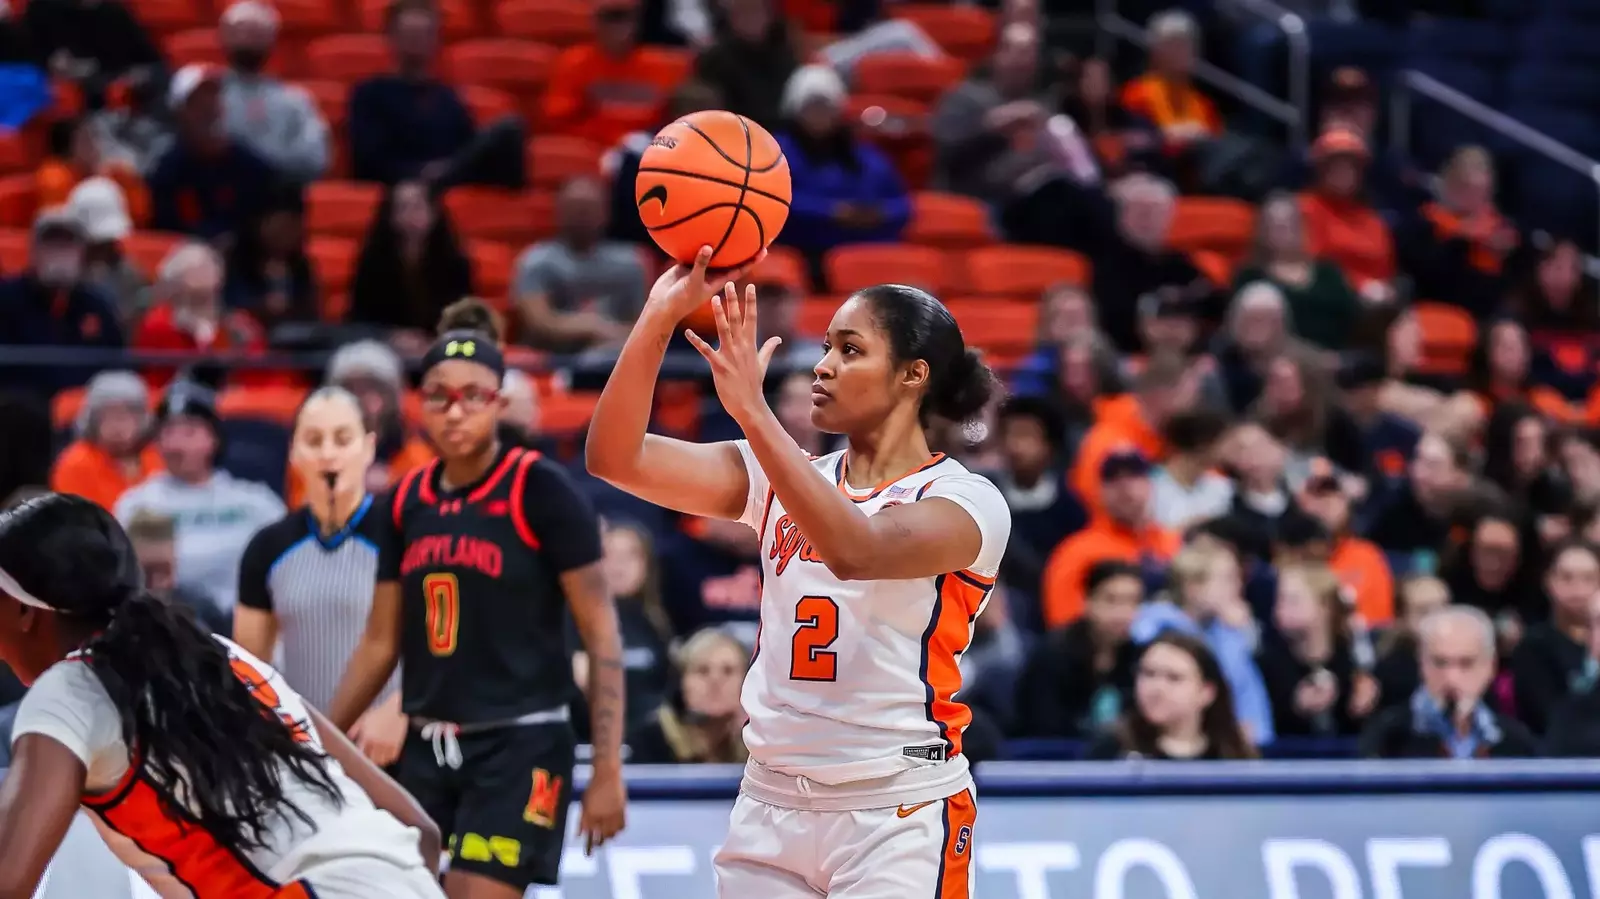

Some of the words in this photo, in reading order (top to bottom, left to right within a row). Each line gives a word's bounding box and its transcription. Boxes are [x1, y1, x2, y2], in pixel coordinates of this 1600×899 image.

[423, 572, 459, 657] 0
[790, 595, 839, 682] 2
[930, 750, 938, 760] M
[955, 825, 972, 855] S
